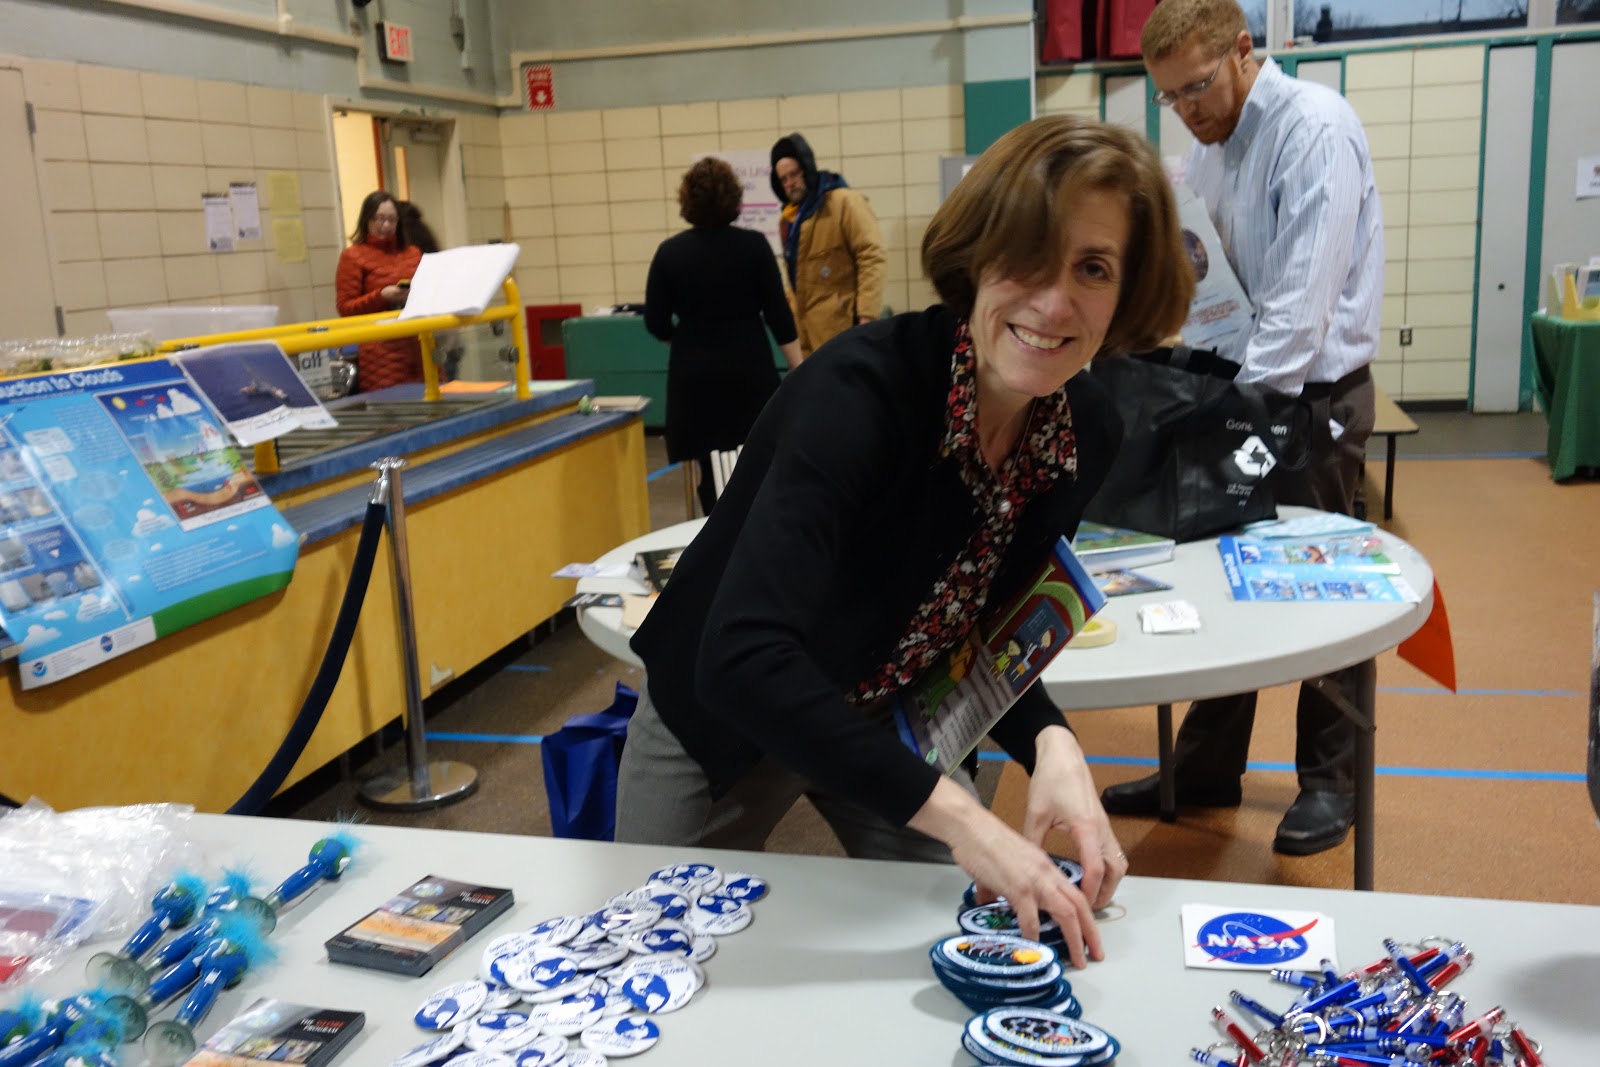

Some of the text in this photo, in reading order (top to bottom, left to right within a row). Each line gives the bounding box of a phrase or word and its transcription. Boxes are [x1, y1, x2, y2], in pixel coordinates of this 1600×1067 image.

[389, 26, 410, 56] EXIT
[49, 376, 71, 391] to
[69, 368, 124, 387] Clouds
[1206, 933, 1303, 957] NASA
